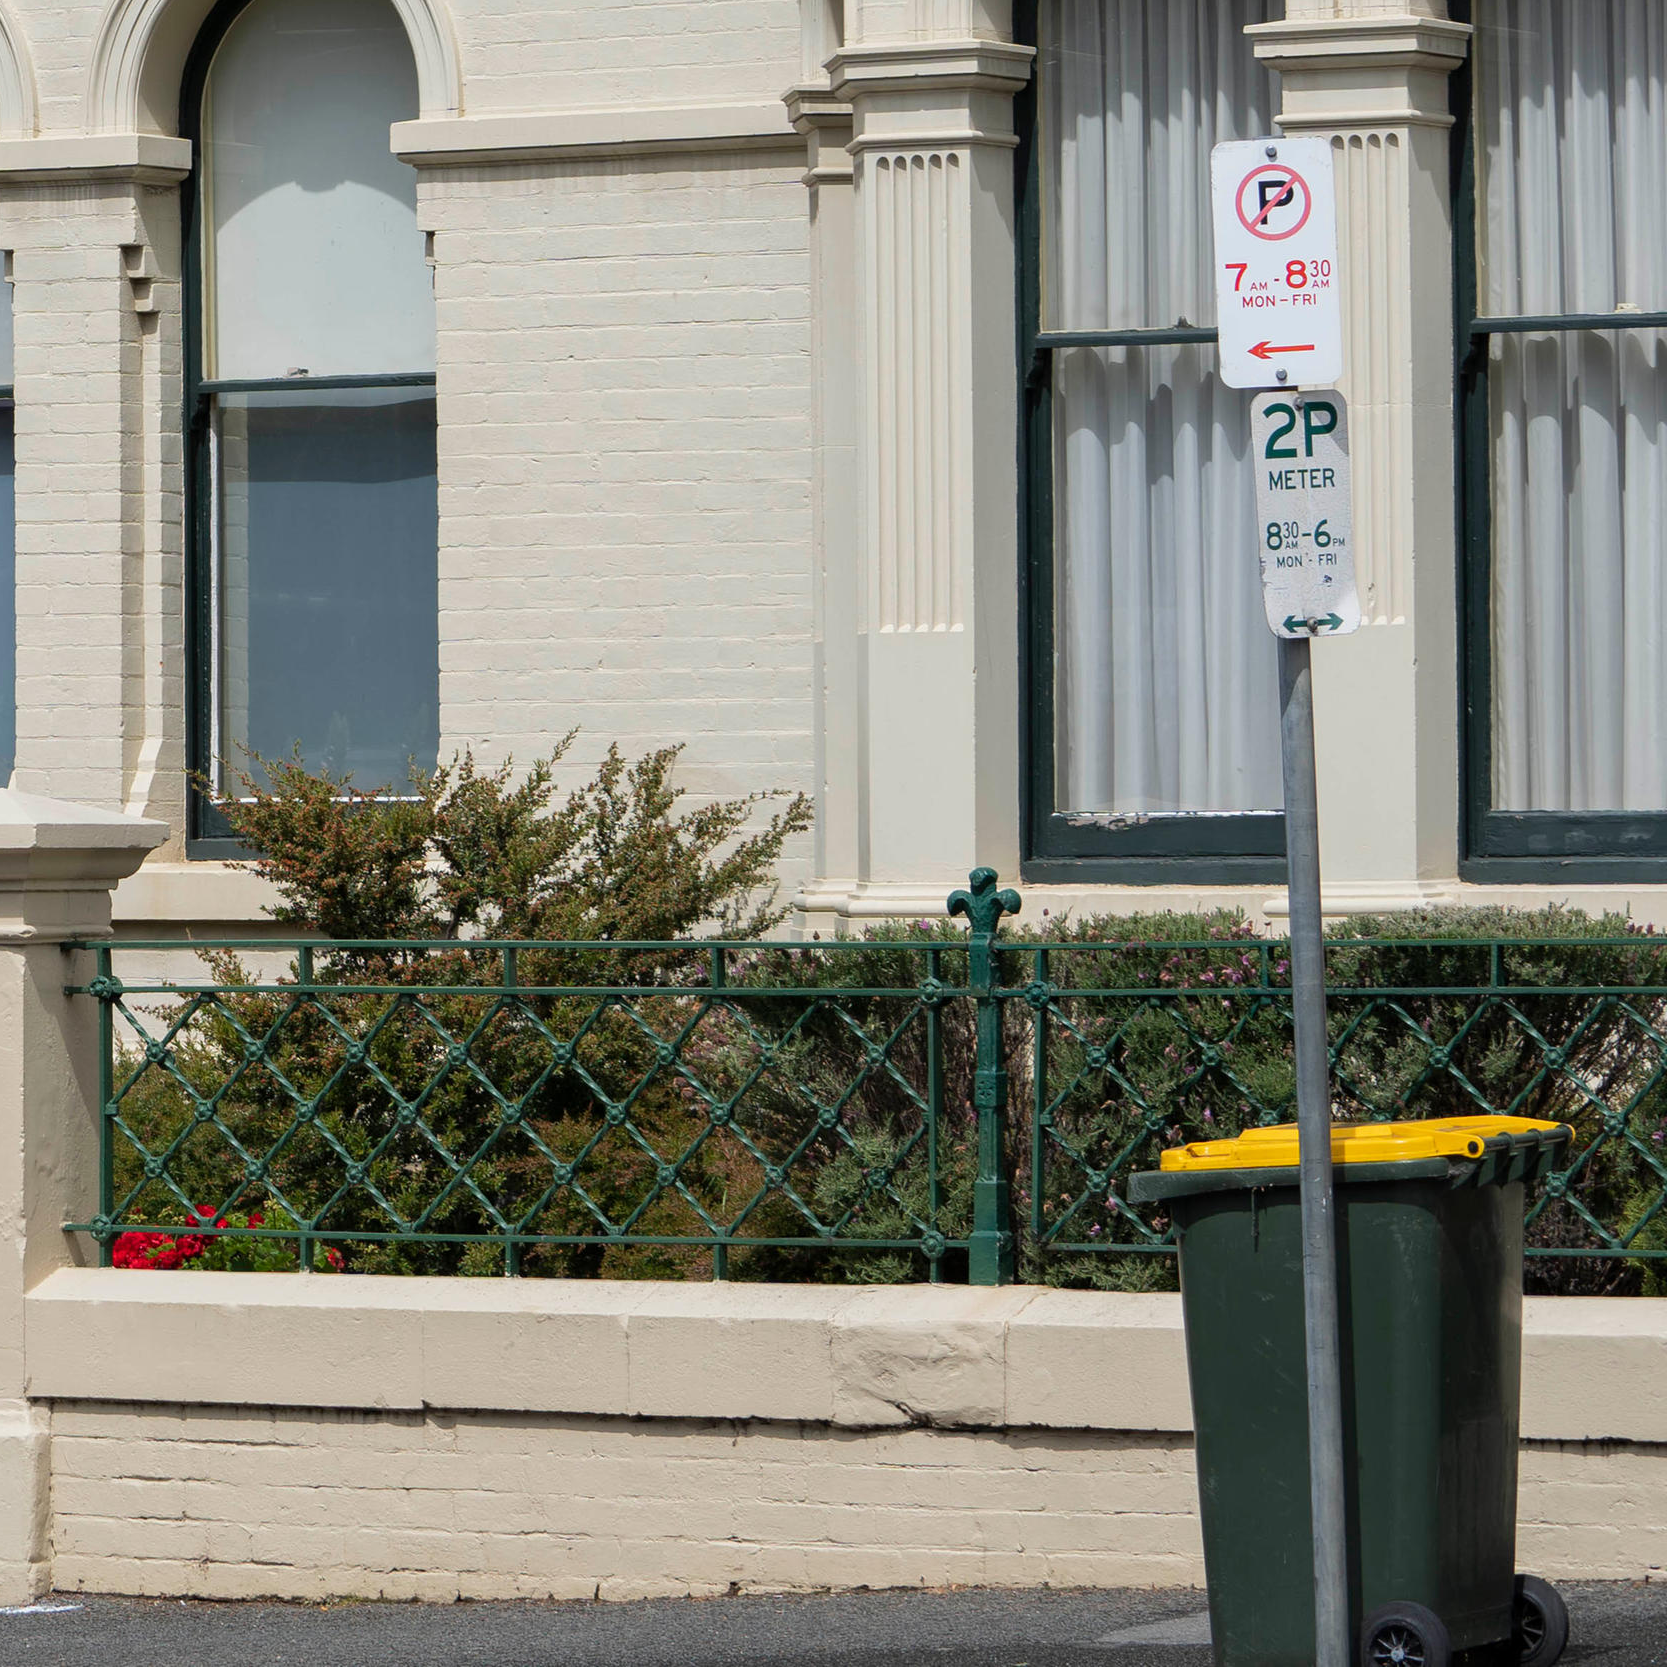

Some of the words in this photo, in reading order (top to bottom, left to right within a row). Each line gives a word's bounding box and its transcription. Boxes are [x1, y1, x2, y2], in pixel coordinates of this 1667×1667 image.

[1242, 295, 1276, 307] MON
[1292, 294, 1317, 305] FRI
[1263, 401, 1337, 459] 2P
[1269, 468, 1334, 490] METER
[1276, 556, 1303, 568] MON
[1318, 554, 1337, 565] FRI
